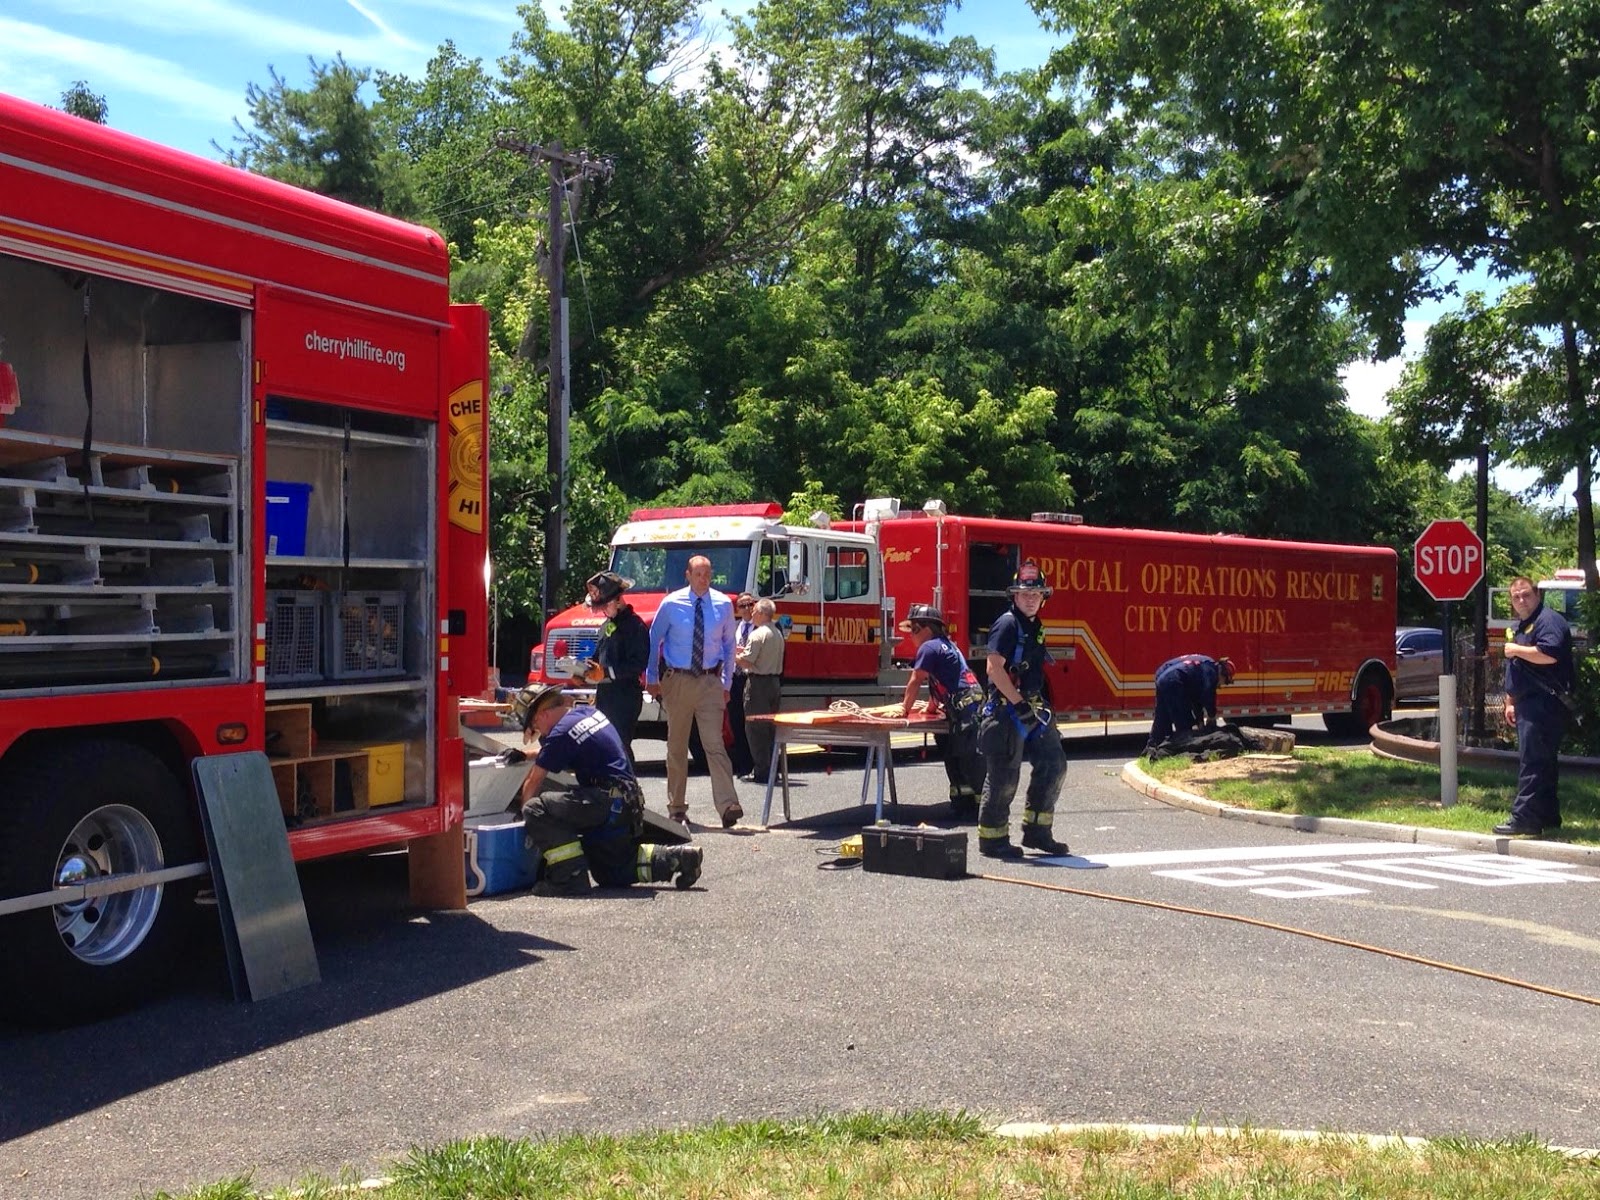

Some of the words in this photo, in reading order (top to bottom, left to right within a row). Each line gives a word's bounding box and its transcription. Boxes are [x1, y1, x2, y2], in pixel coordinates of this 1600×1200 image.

[305, 330, 405, 371] cherryhillfire.org
[450, 399, 481, 417] CHE
[1420, 545, 1479, 576] STOP
[1141, 563, 1276, 599] OPERATIONS
[1287, 570, 1360, 601] RESCUE
[825, 617, 869, 644] CAMDEN
[1125, 605, 1172, 633] CITY
[1178, 606, 1203, 633] OF
[1212, 608, 1286, 634] CAMDEN
[1315, 671, 1350, 692] FIRE
[1151, 854, 1600, 899] STOP
